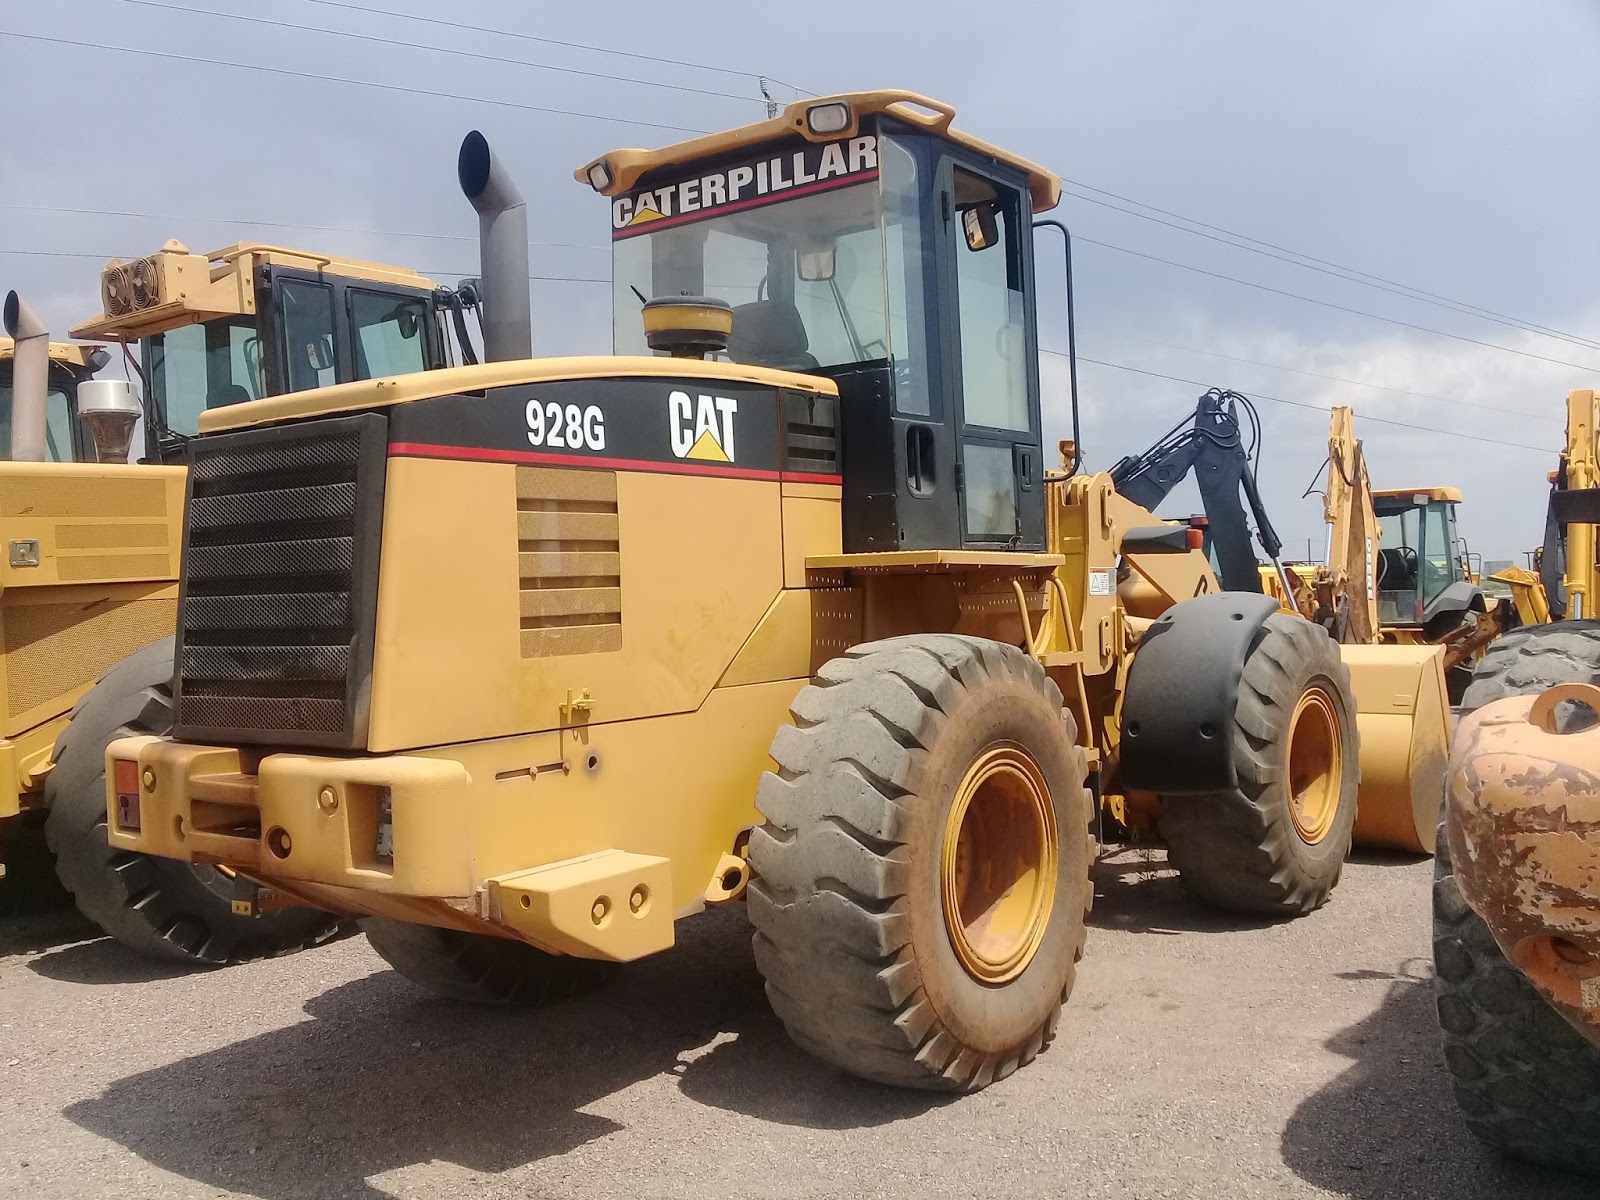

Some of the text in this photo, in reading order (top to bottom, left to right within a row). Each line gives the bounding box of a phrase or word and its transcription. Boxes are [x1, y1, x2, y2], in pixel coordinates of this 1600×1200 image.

[612, 136, 878, 229] CATERPILLAR
[525, 399, 606, 451] 928G
[668, 390, 738, 462] CAT
